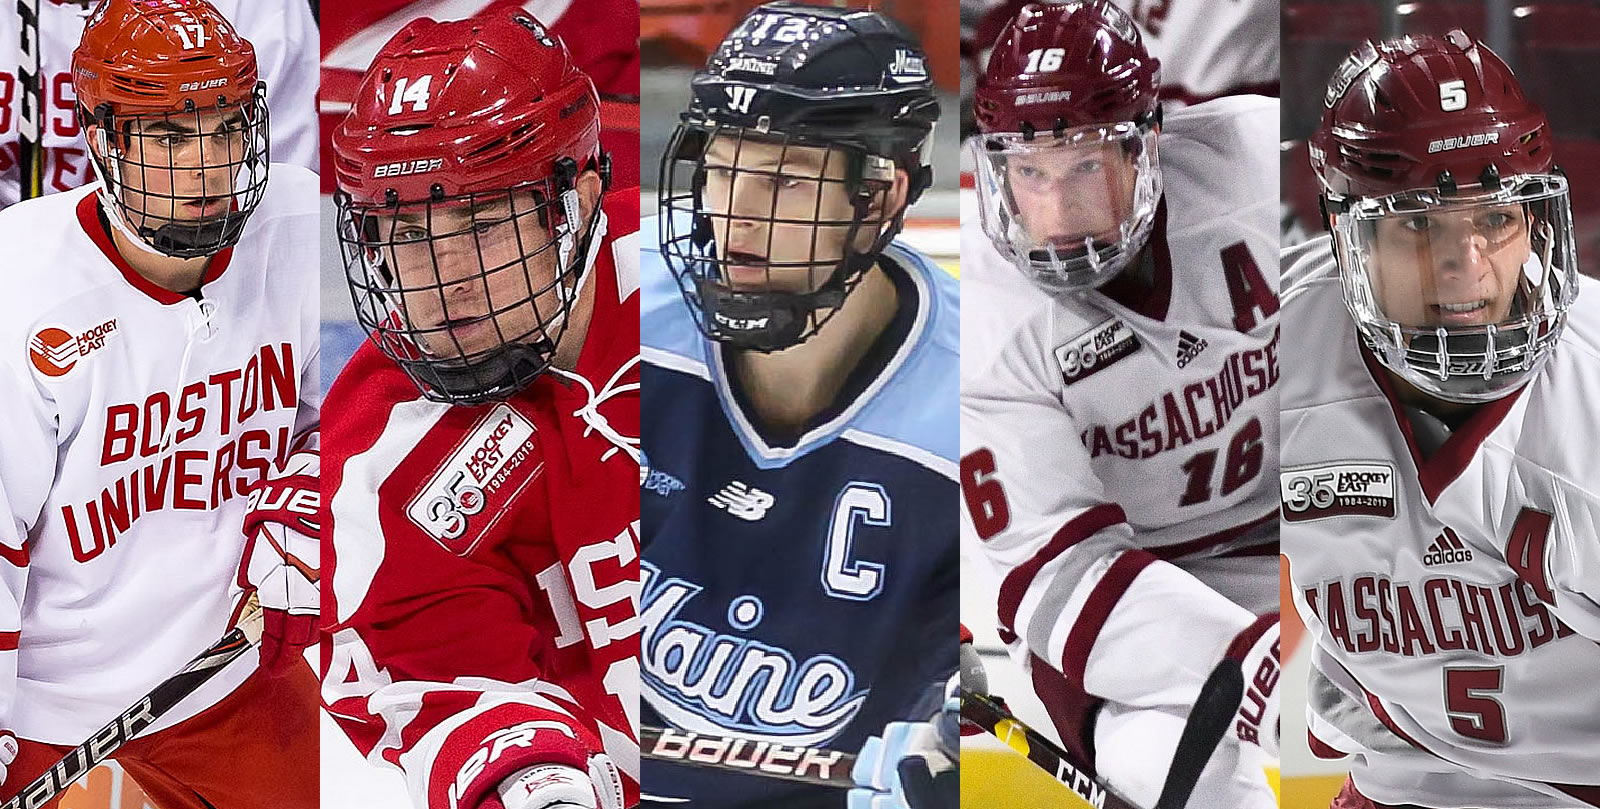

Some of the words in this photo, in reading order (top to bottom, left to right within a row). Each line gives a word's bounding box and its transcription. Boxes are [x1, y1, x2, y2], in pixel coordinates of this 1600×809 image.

[175, 24, 210, 50] 17
[1024, 48, 1066, 73] 16
[179, 78, 228, 92] BAUER
[388, 75, 432, 115] 14
[1439, 80, 1468, 112] 5
[1428, 131, 1499, 153] BAUER
[374, 158, 443, 178] BAUER
[1220, 240, 1280, 333] A
[76, 319, 117, 346] HOCKEY
[79, 336, 106, 357] EAST
[1063, 337, 1098, 377] 35
[1177, 338, 1209, 369] adidas
[101, 343, 297, 467] BOSTON
[465, 413, 514, 474] HOCKEY
[1178, 416, 1266, 507] 16
[470, 444, 504, 484] EAST
[486, 440, 535, 494] 1984-2019
[1338, 472, 1390, 485] HOCKEY
[427, 470, 487, 539] 35
[1287, 472, 1335, 512] 35
[1337, 482, 1369, 493] EAST
[821, 481, 891, 601] C
[1423, 548, 1473, 566] adidas
[1505, 507, 1557, 607] A
[1443, 664, 1511, 746] 5
[652, 730, 843, 778] BAUER
[1056, 757, 1107, 809] CCM
